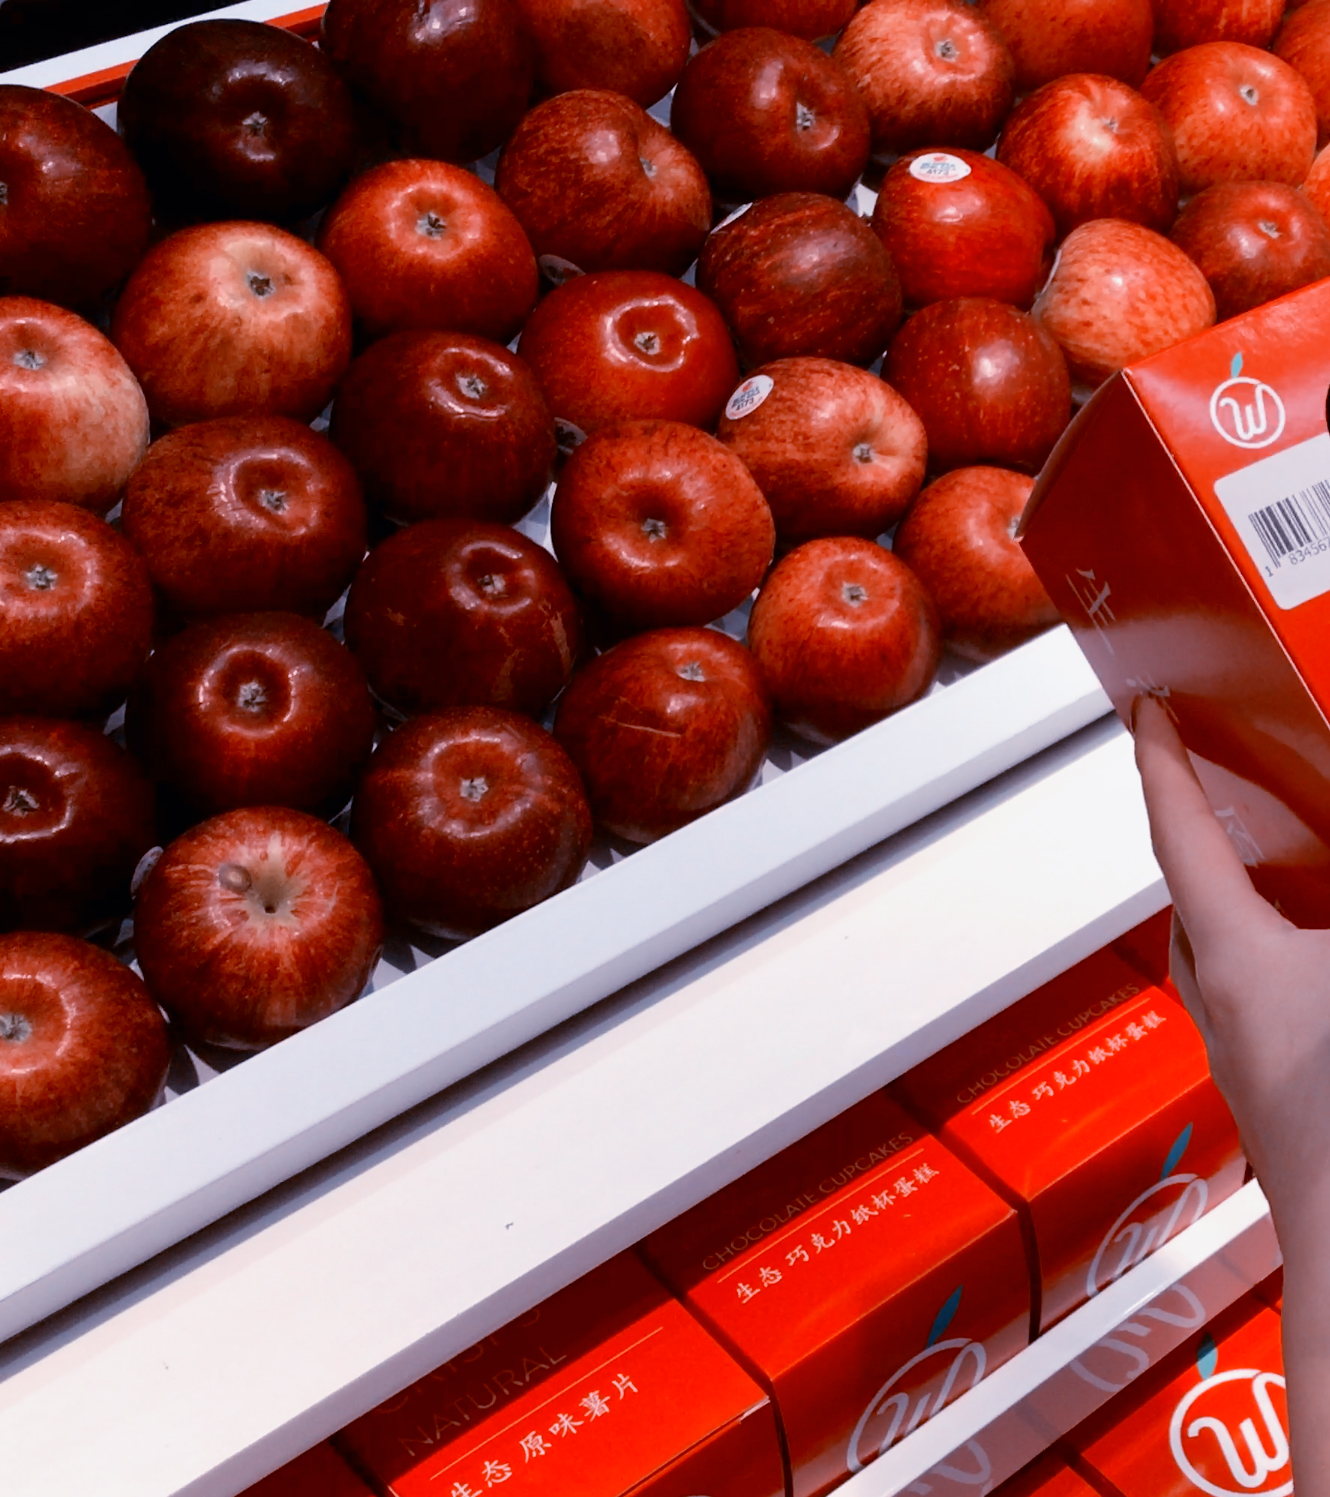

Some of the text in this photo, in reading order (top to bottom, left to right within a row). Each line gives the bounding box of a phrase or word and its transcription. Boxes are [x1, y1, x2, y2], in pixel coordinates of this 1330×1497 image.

[956, 983, 1140, 1105] CHOCOLATE CUPCAKES
[702, 1131, 915, 1271] CHOCOLATE CUPCAKES
[398, 1345, 568, 1457] NATURAL
[518, 1371, 640, 1464] 原味薯片
